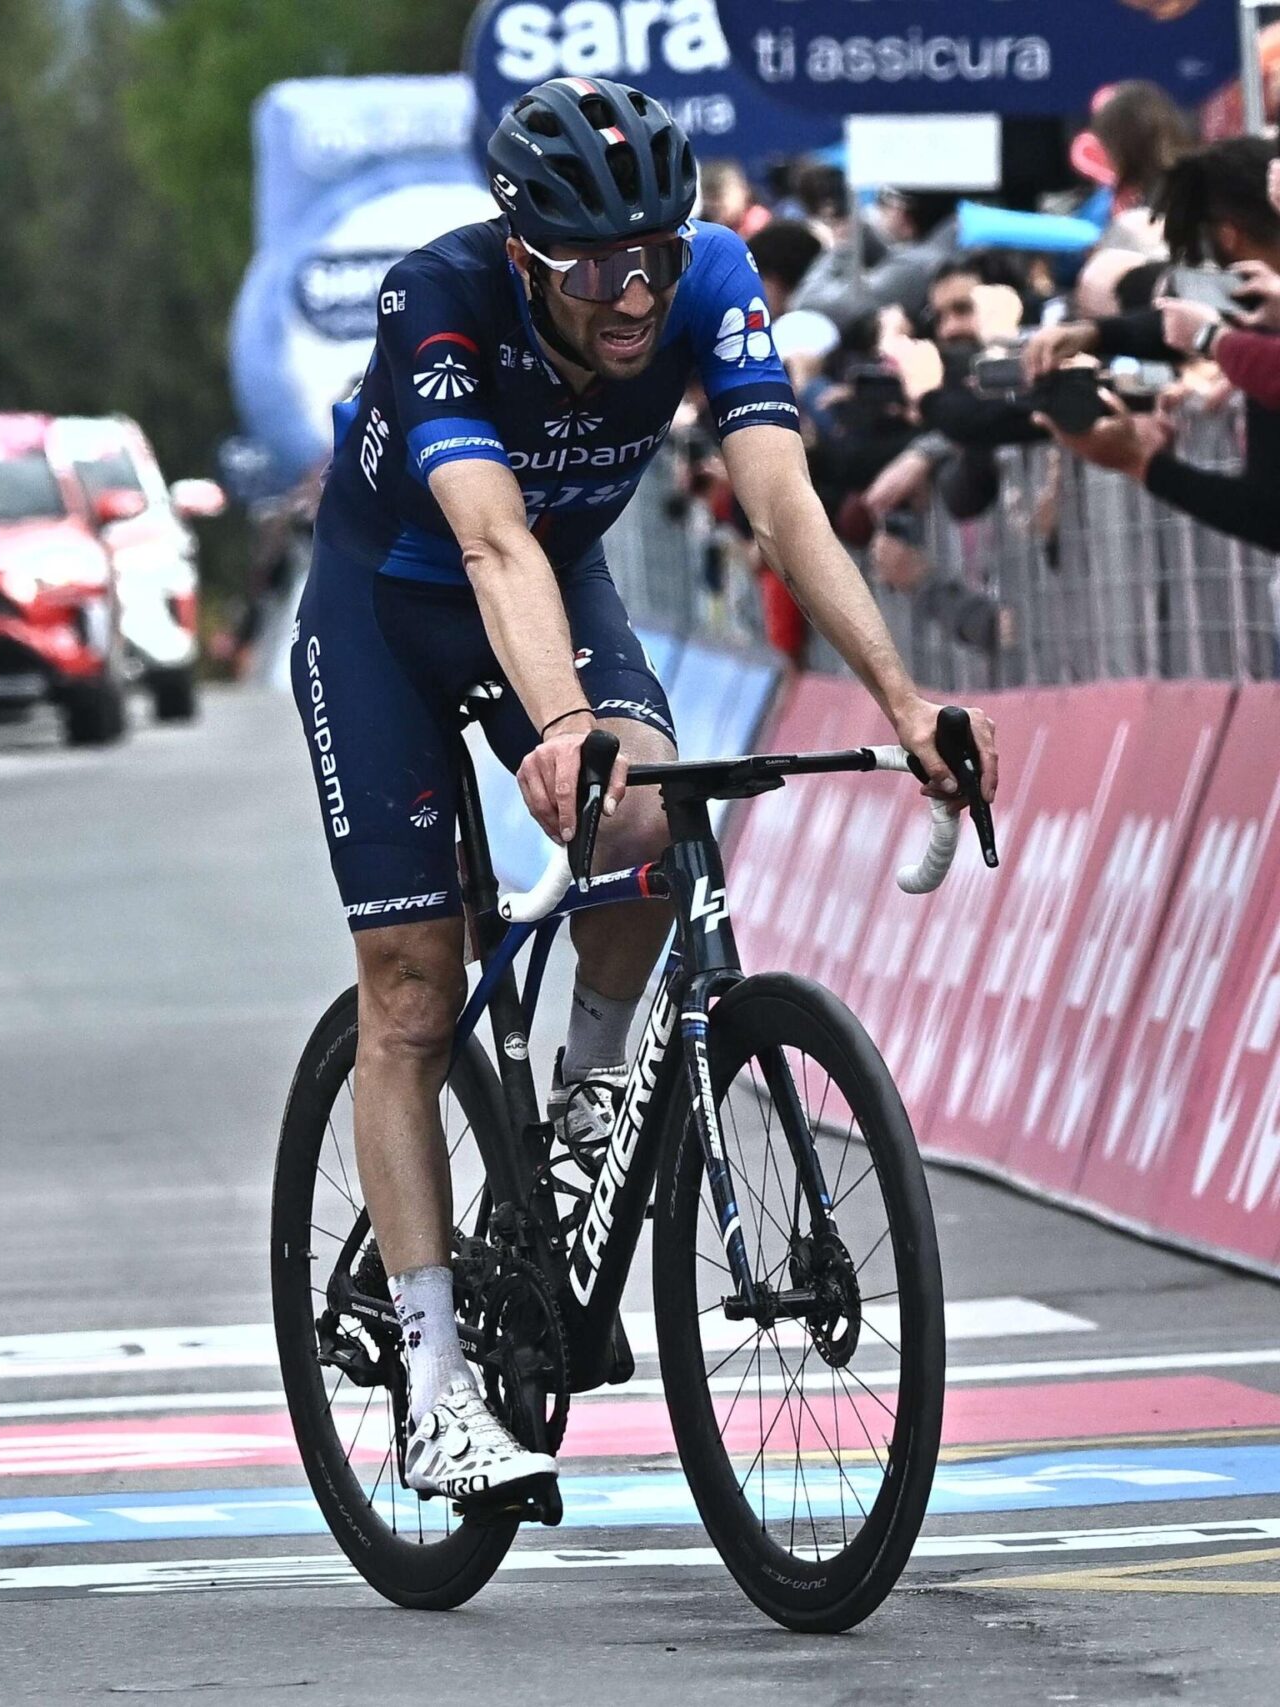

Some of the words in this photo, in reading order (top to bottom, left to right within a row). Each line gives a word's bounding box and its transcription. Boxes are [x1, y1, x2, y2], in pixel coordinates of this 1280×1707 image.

[495, 0, 730, 82] sara
[754, 27, 796, 82] ti
[807, 27, 1051, 82] assicura
[306, 635, 351, 839] Groupama
[569, 973, 678, 1308] LAPIERRE
[694, 1040, 724, 1161] LAPIERRE
